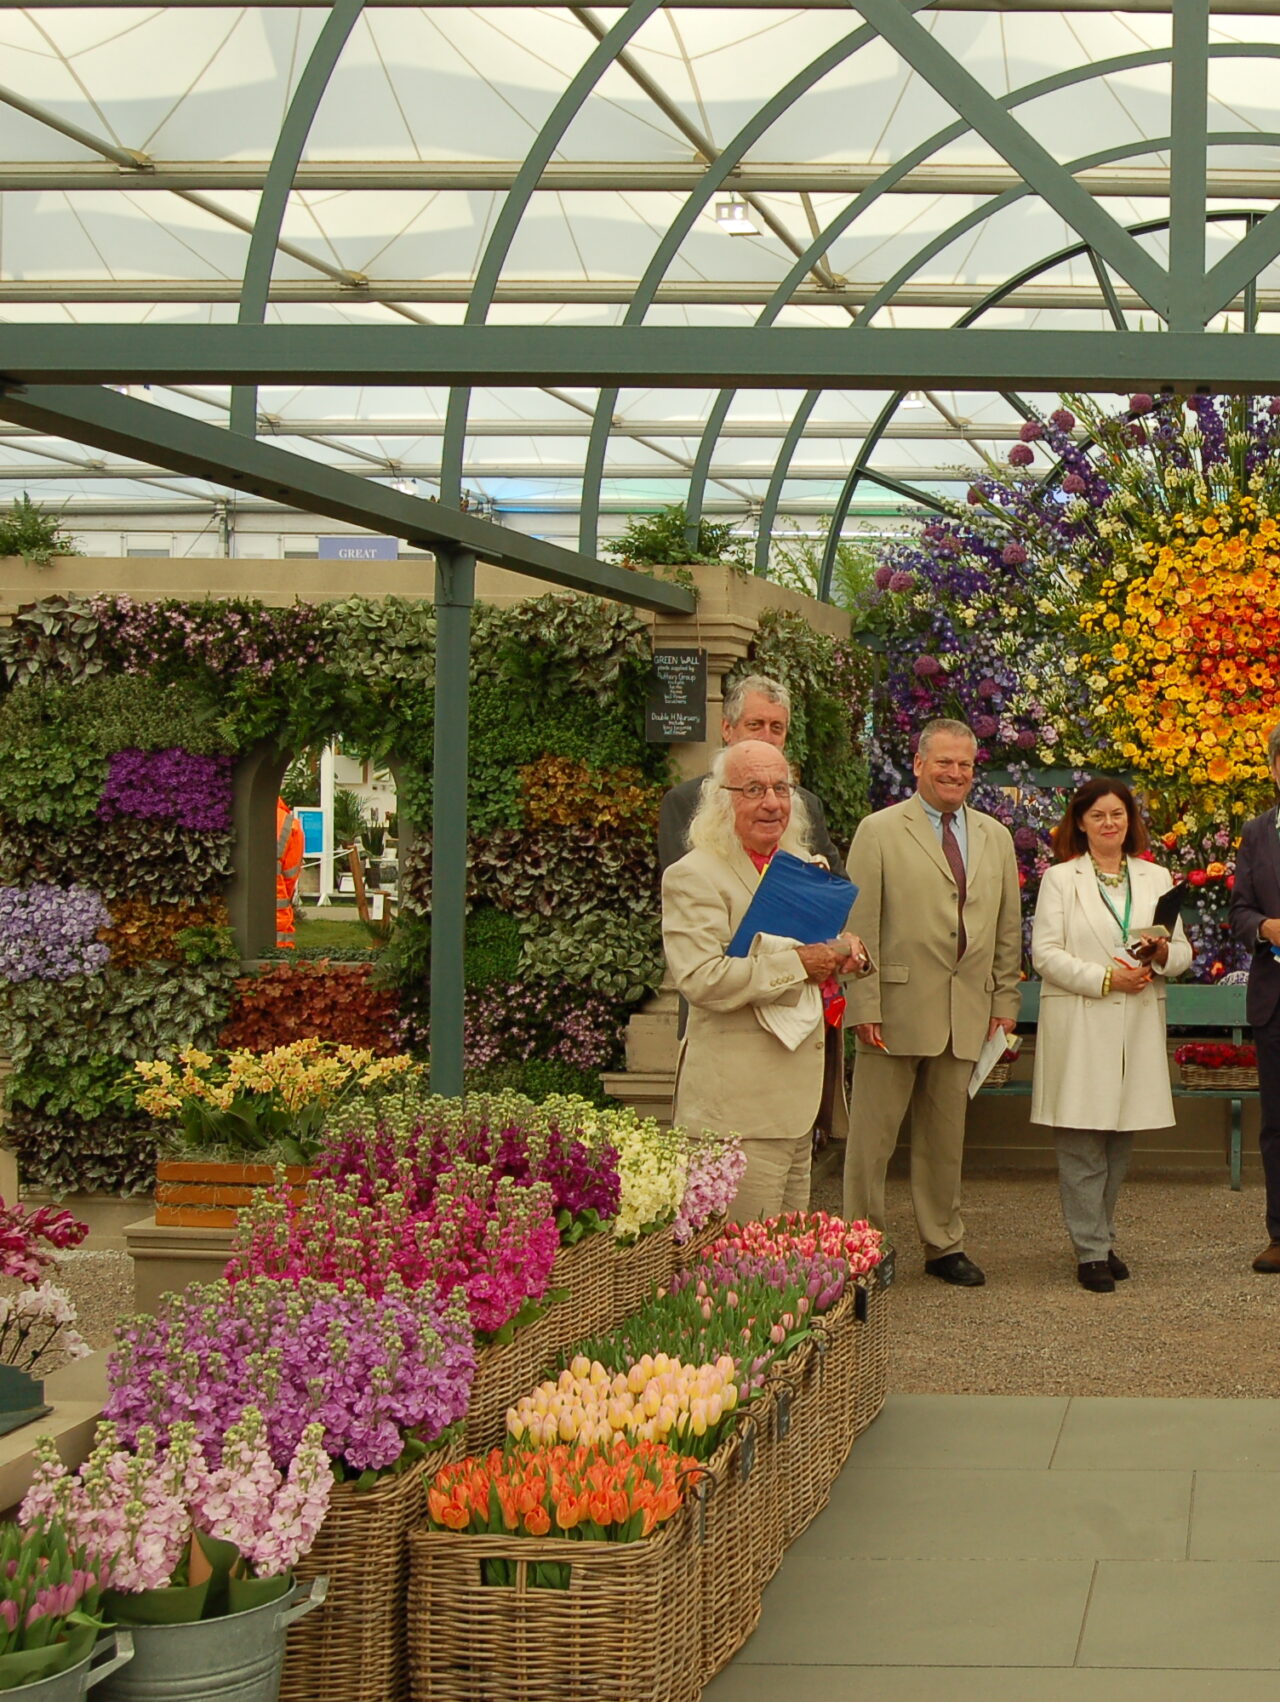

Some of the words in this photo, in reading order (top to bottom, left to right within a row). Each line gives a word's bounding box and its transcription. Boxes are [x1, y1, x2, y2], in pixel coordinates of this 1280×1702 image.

[339, 548, 377, 559] GREAT
[654, 655, 678, 665] GREEN
[680, 655, 700, 665] WALL
[678, 672, 697, 683] Group
[651, 712, 669, 720] Double
